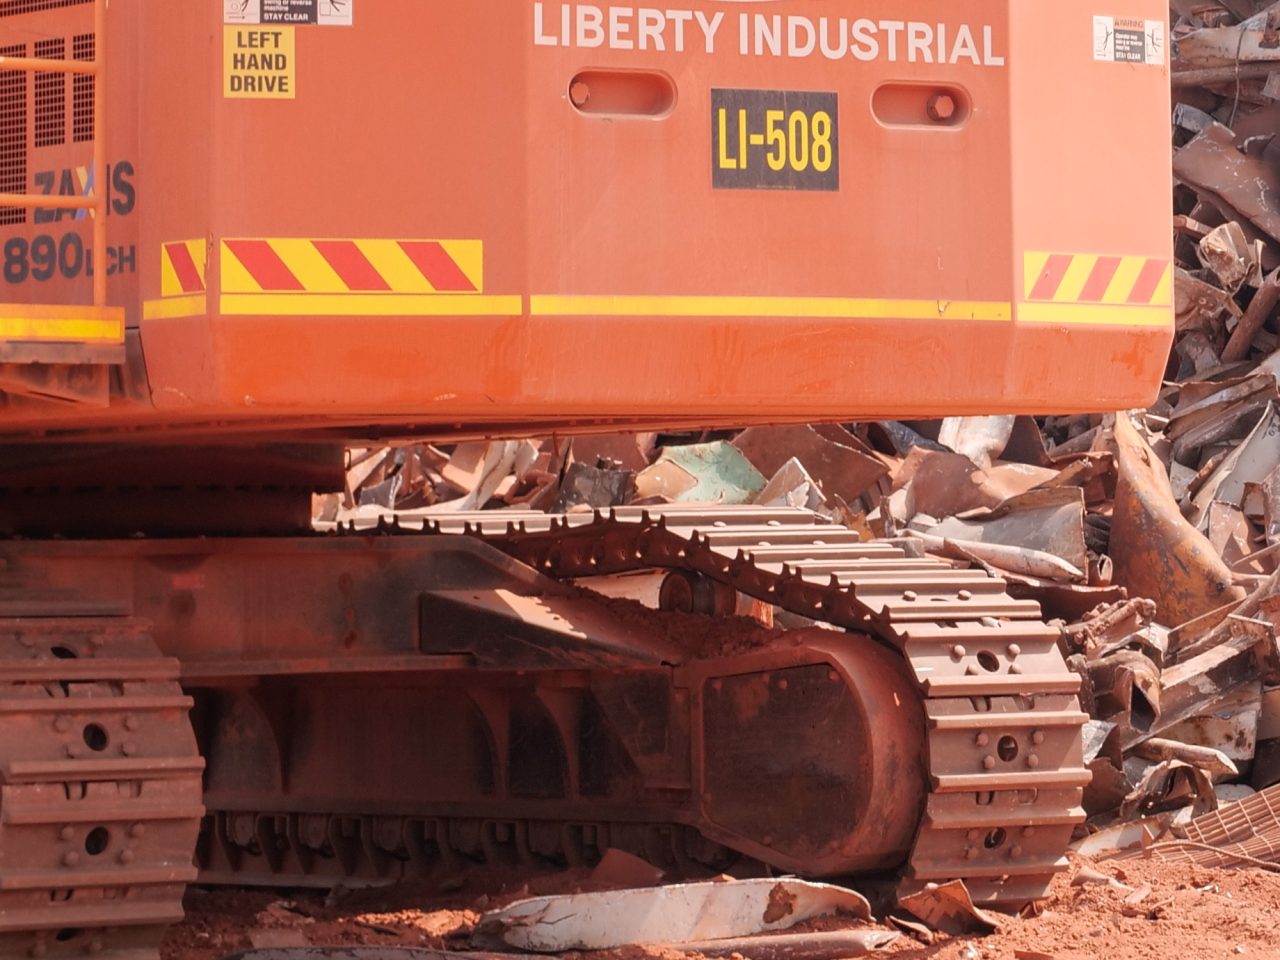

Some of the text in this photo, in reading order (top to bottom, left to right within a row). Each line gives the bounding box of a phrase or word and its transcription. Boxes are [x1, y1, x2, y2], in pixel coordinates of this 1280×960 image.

[284, 13, 309, 21] CLEAR
[237, 31, 282, 48] LEFT
[533, 2, 1005, 66] LIBERTY INDUSTRIAL
[232, 53, 287, 70] HAND
[230, 75, 289, 92] DRIVE
[718, 108, 832, 172] LI-508
